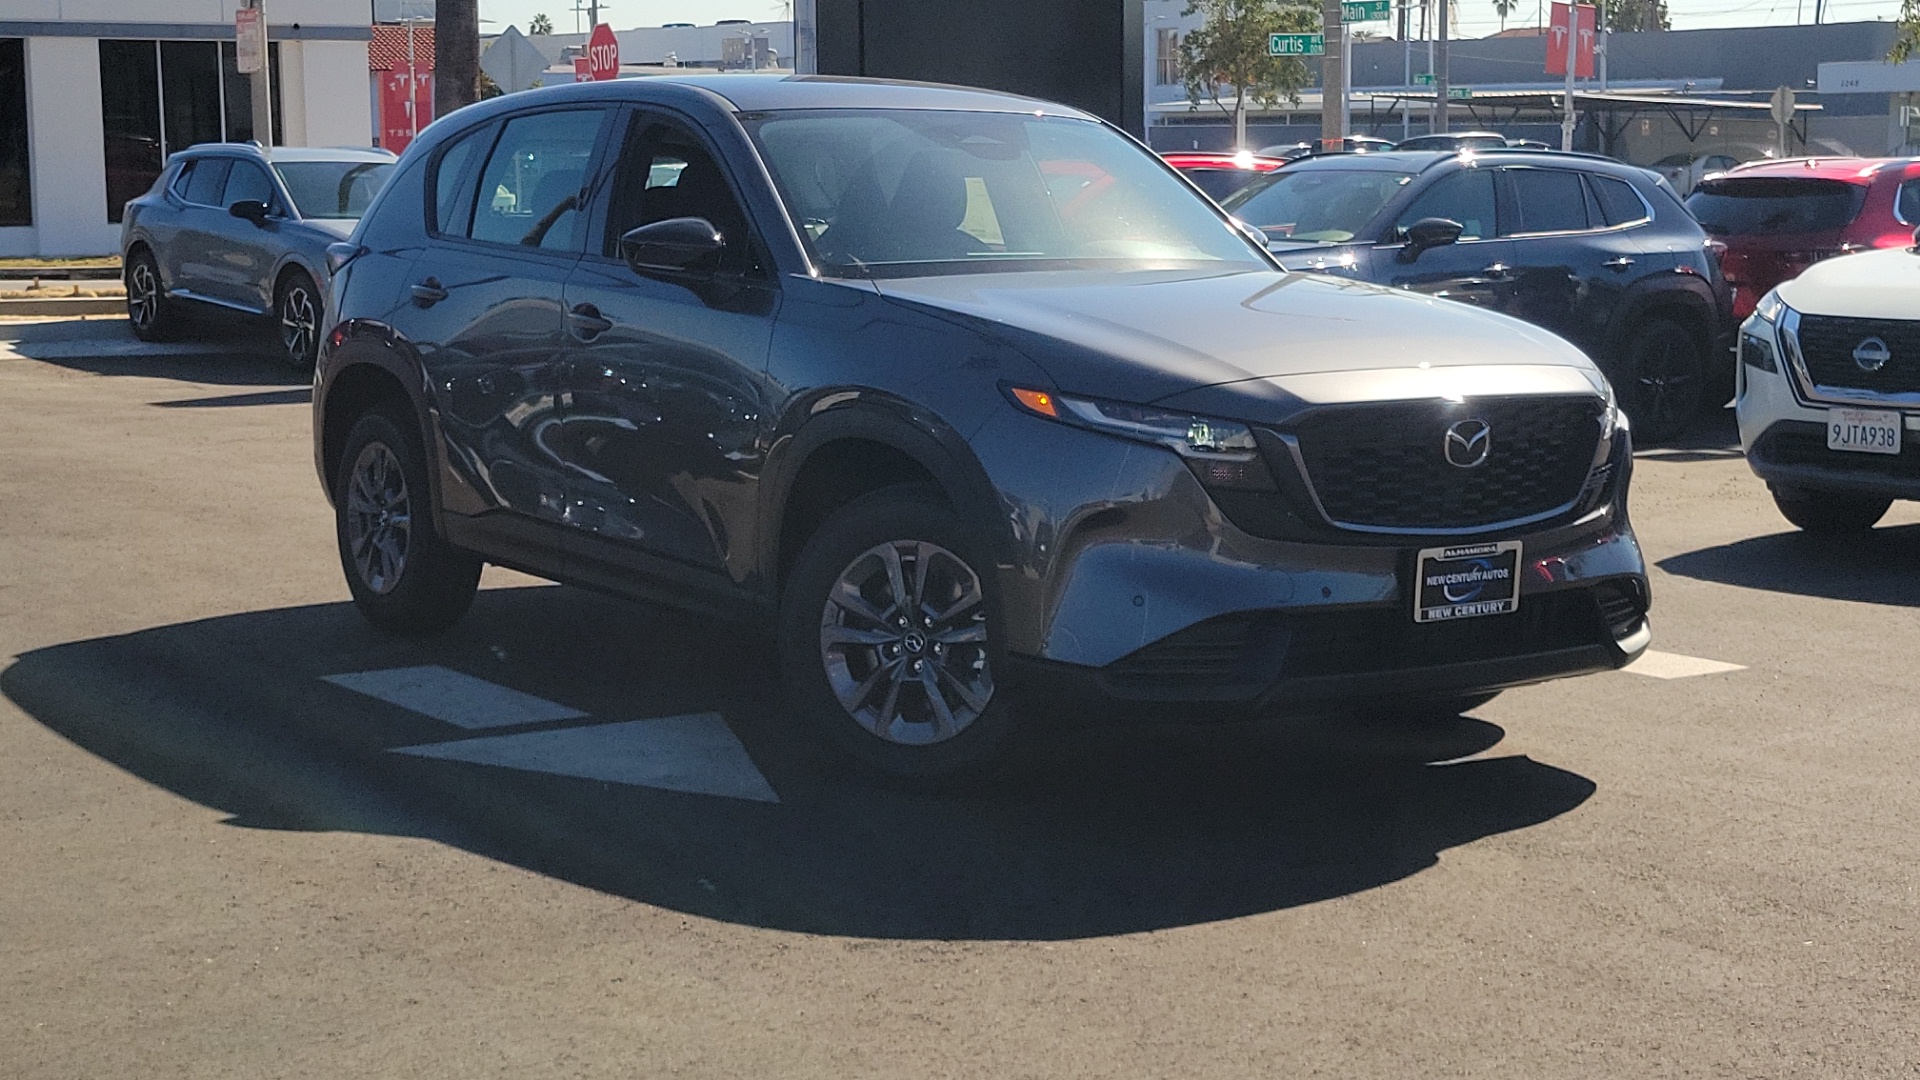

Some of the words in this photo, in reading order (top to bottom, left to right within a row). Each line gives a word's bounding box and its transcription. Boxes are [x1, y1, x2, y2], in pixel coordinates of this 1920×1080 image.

[1341, 4, 1365, 20] Main
[1272, 36, 1303, 53] Curtis
[591, 44, 617, 72] STOP
[1833, 424, 1895, 447] 9JTA938
[1428, 607, 1452, 619] NEW
[1455, 602, 1505, 616] CENTURY
